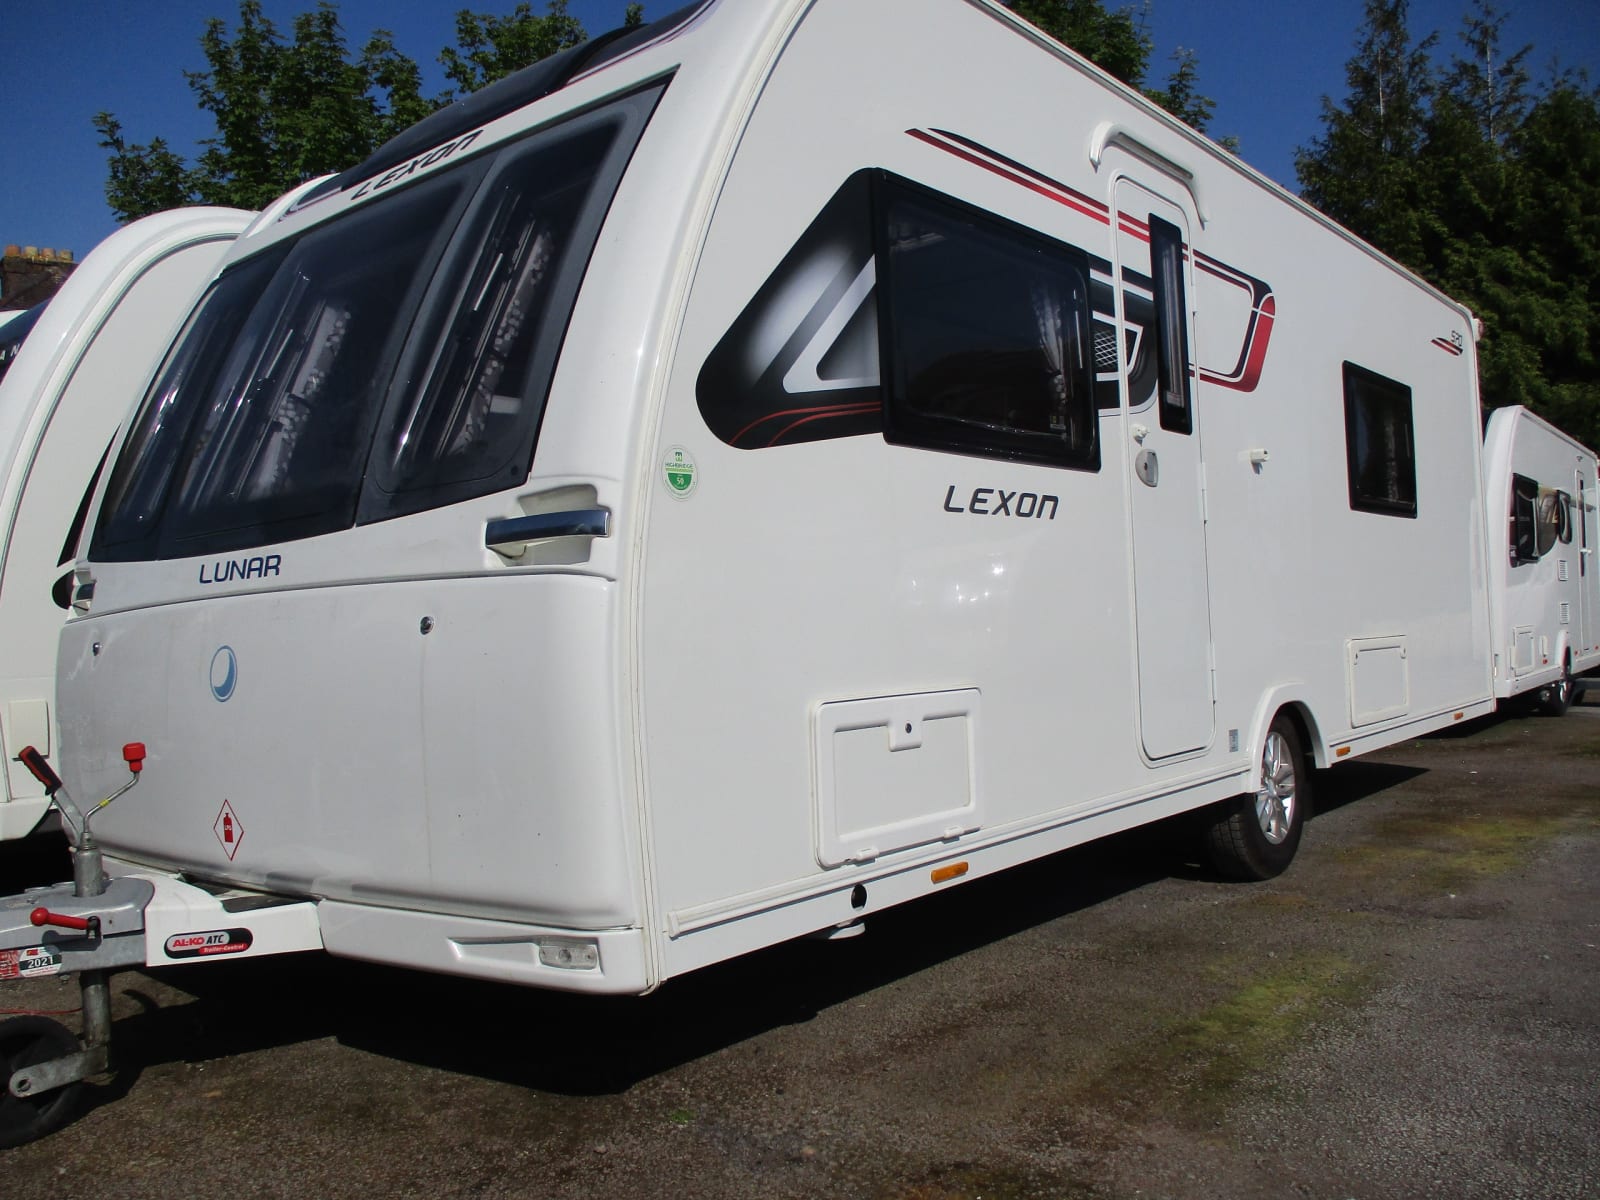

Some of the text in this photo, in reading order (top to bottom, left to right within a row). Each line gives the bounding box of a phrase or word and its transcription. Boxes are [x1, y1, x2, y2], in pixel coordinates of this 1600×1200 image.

[199, 554, 282, 584] LUNAR
[206, 934, 225, 945] ATC
[27, 956, 54, 969] 2021
